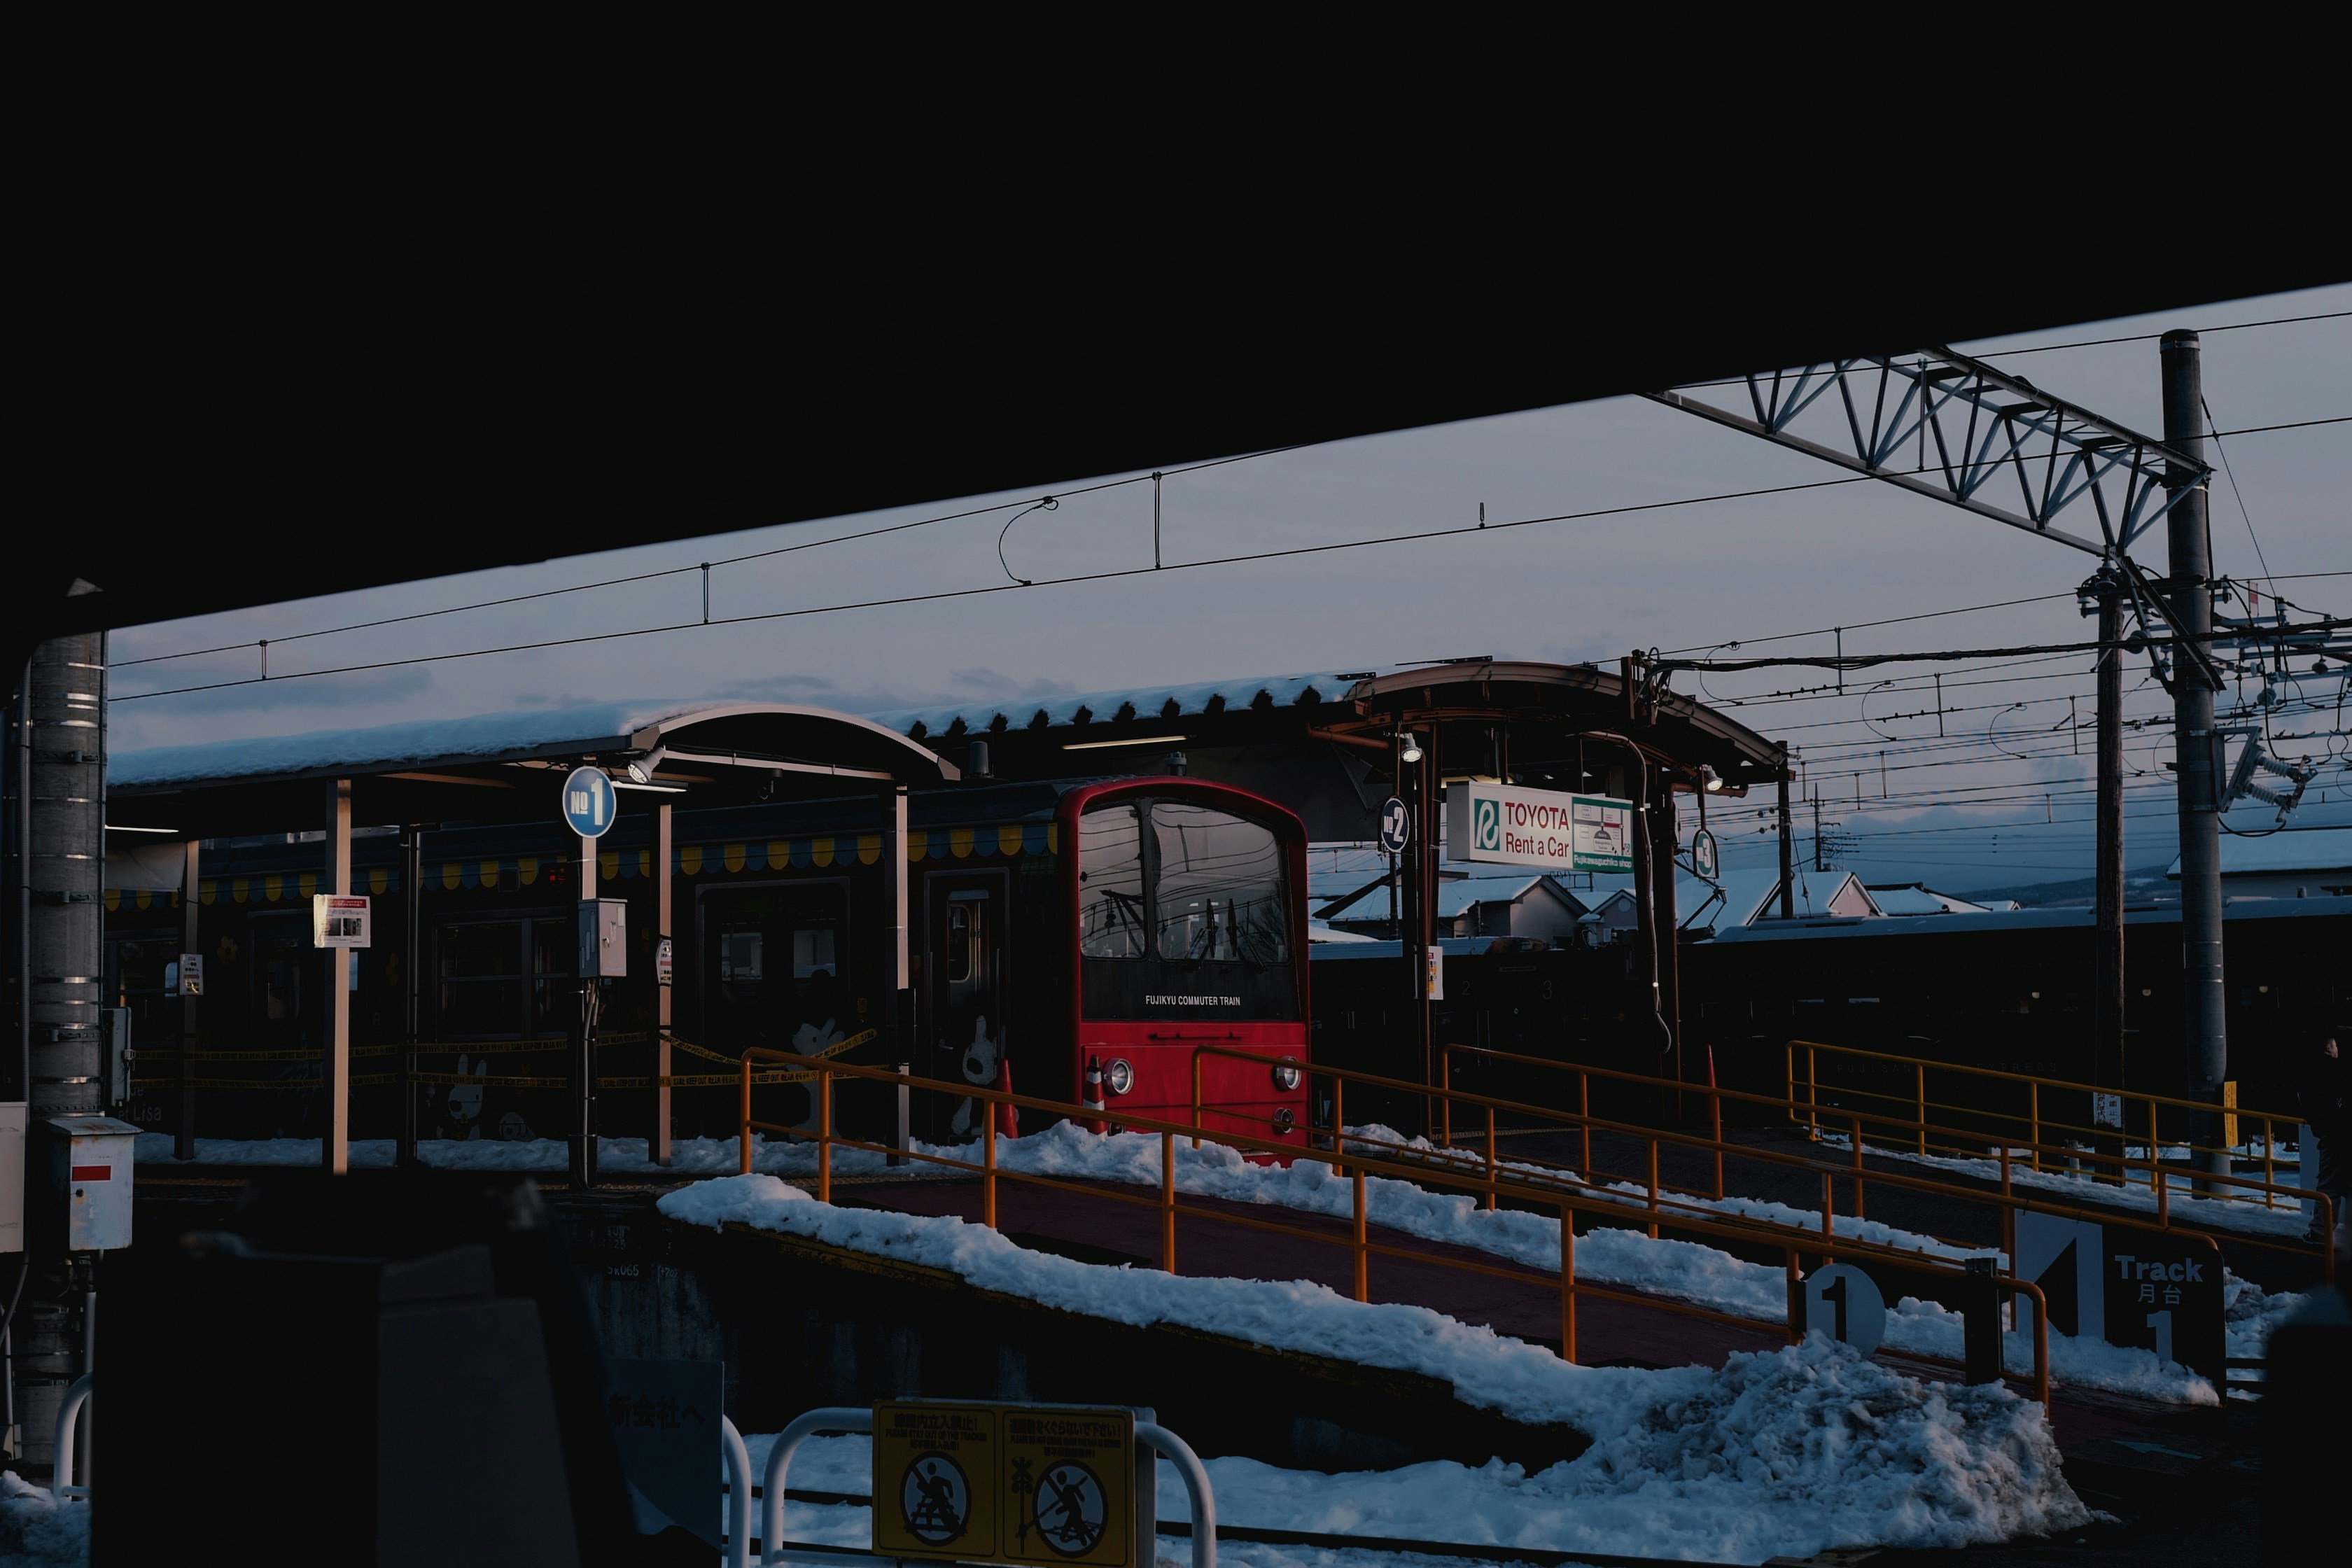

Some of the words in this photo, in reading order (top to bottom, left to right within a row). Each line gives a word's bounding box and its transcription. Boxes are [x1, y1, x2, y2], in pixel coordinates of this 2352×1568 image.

[1505, 802, 1569, 831] TOYOTA
[1506, 832, 1534, 855] Rent
[1538, 841, 1544, 855] a
[1548, 836, 1569, 858] Car
[1619, 858, 1632, 868] shop
[1145, 995, 1176, 1005] FUJIKYU
[1178, 995, 1218, 1005] COMMUTER
[1219, 996, 1240, 1006] TRAIN
[1837, 1064, 1911, 1074] FUJISAN
[133, 1102, 162, 1121] Lisa
[2115, 1254, 2204, 1282] Track
[2138, 1283, 2183, 1306] 月台
[1821, 1275, 1847, 1344] 1
[2146, 1310, 2173, 1363] 1
